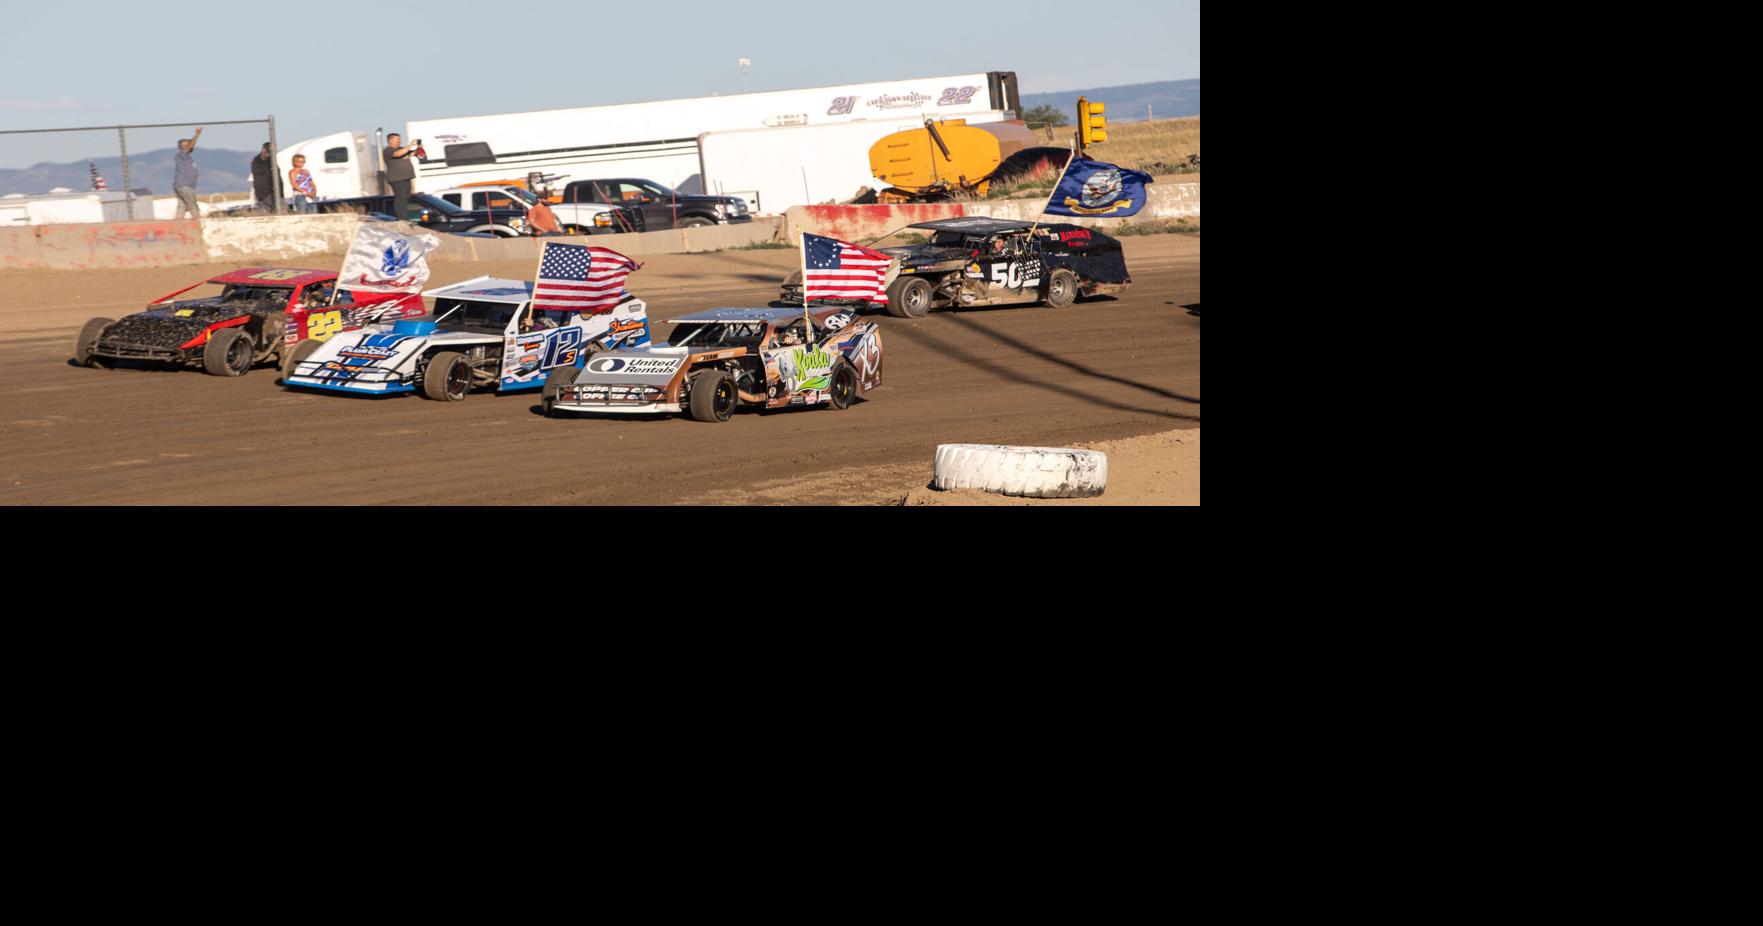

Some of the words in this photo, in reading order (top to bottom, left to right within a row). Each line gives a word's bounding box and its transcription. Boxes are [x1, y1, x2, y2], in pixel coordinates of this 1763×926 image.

[307, 310, 343, 343] 22
[541, 328, 582, 371] 12
[624, 366, 674, 374] Rentals
